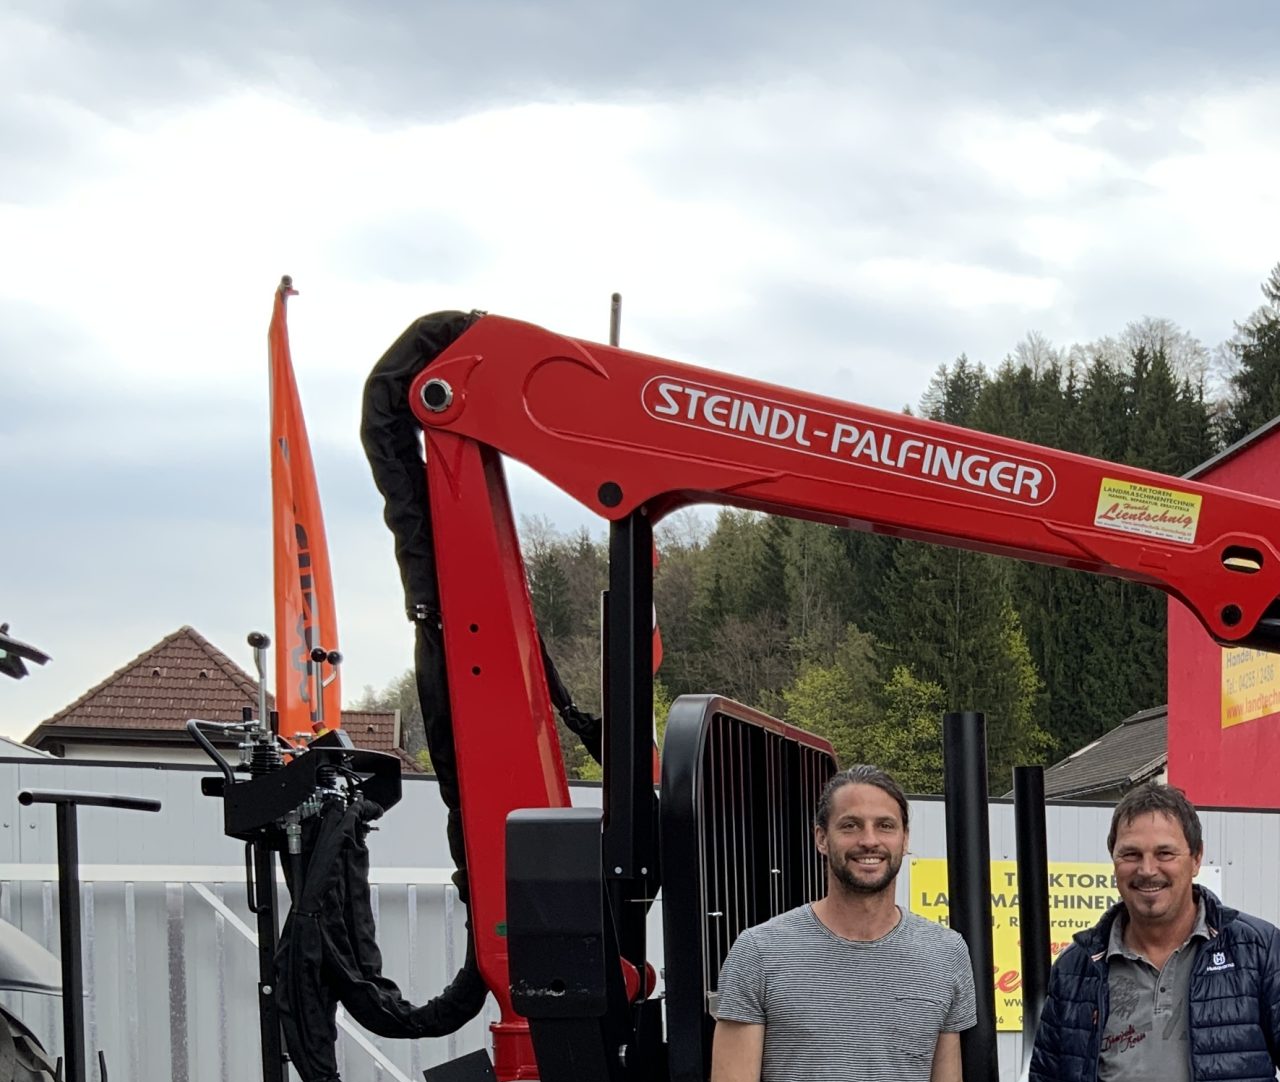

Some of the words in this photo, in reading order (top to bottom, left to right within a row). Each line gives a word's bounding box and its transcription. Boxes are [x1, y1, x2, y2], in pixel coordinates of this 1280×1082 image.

[655, 383, 1043, 499] STEINDL-PALFINGER
[1103, 486, 1195, 508] LANDMASCHINENTECHNIK
[1130, 484, 1172, 497] TRAKTOREN
[1098, 502, 1193, 529] Lientschnig
